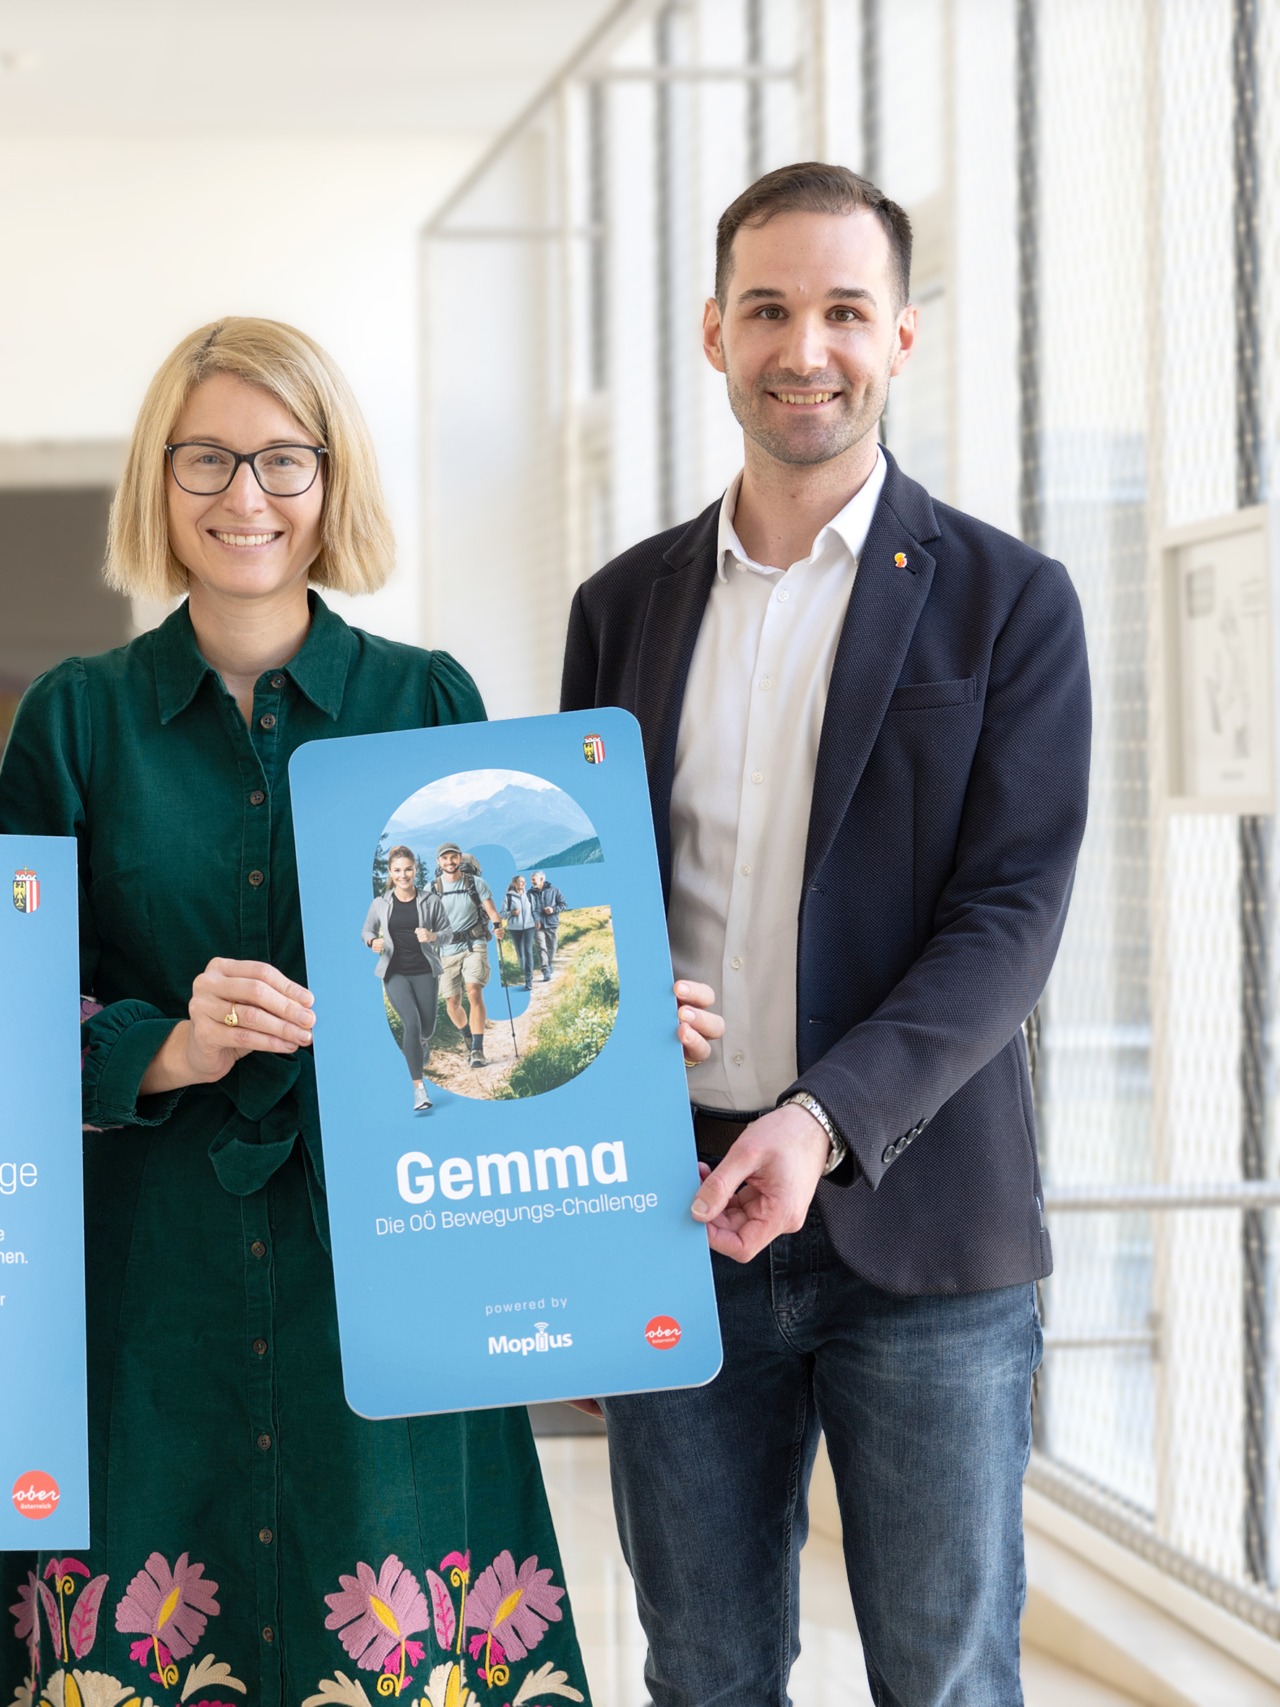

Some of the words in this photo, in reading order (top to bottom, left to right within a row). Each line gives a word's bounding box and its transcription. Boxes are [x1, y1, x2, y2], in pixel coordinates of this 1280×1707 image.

[396, 1141, 628, 1204] Gemma
[375, 1216, 405, 1235] Die
[409, 1211, 436, 1231] OÖ
[441, 1192, 658, 1229] Bewegungs-Challenge
[486, 1299, 545, 1316] powered
[551, 1297, 568, 1309] by
[12, 1485, 60, 1501] ober
